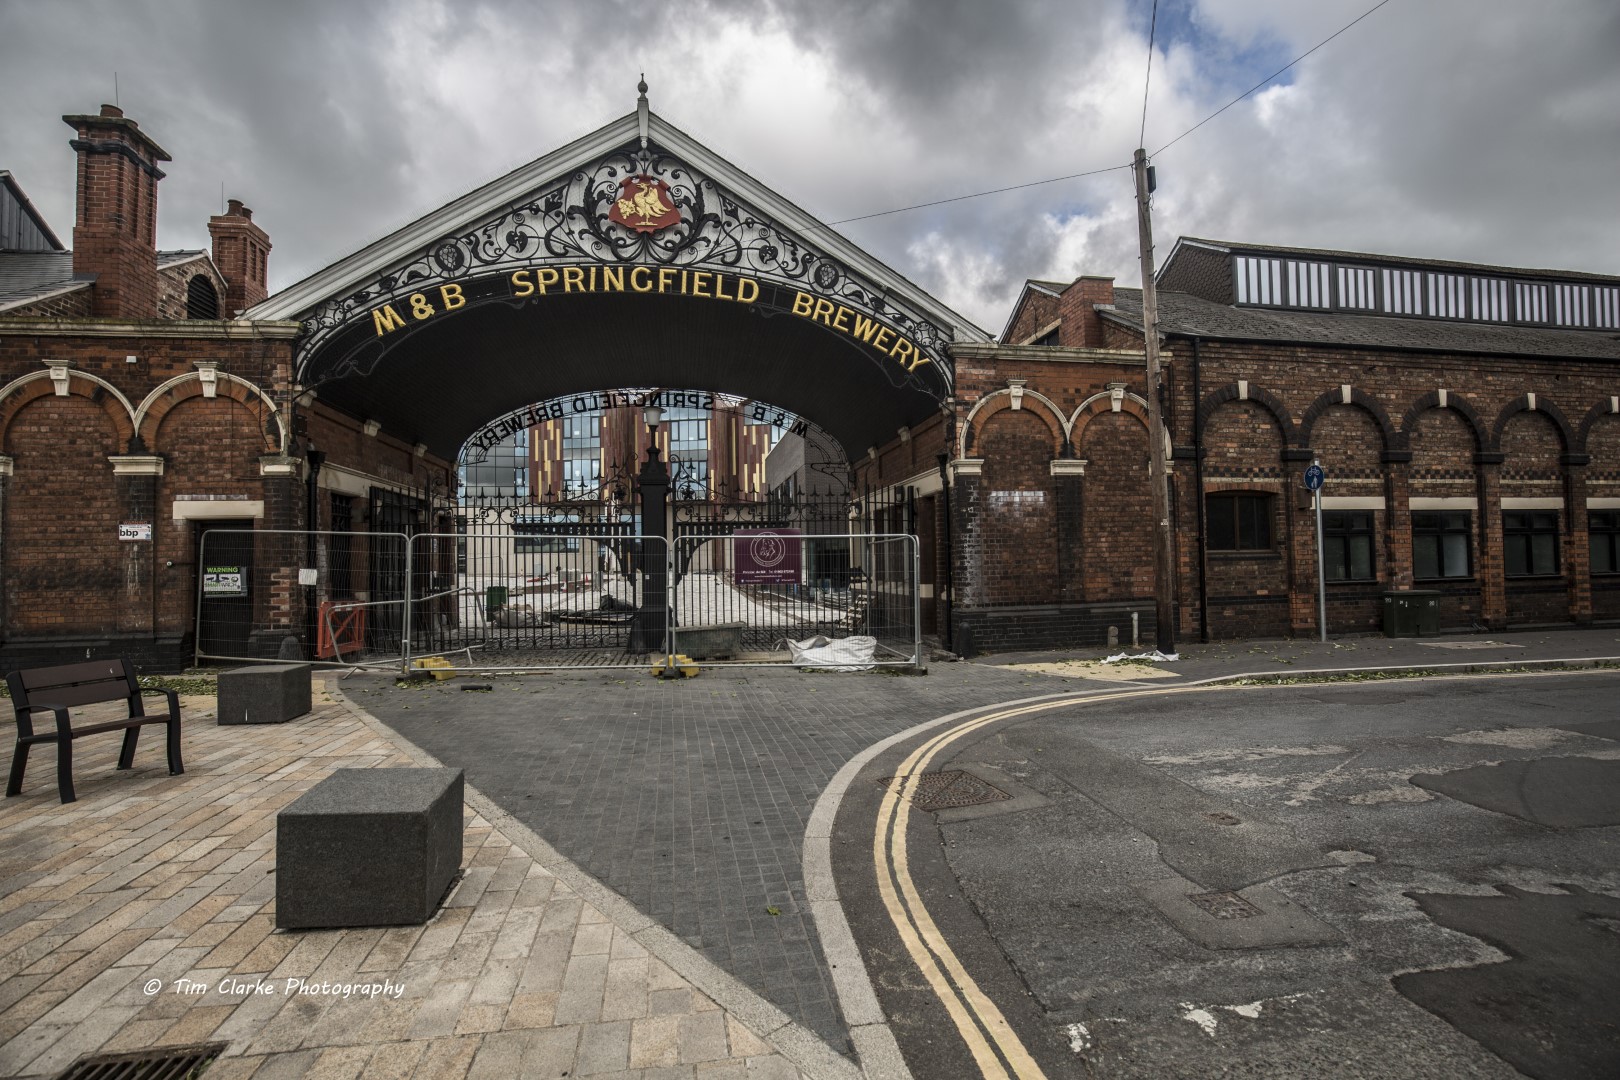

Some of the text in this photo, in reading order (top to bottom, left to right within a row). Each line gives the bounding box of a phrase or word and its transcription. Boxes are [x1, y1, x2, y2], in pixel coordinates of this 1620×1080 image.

[372, 267, 930, 373] M & B SPRINGFIELD BREWERY
[120, 529, 138, 538] bbp
